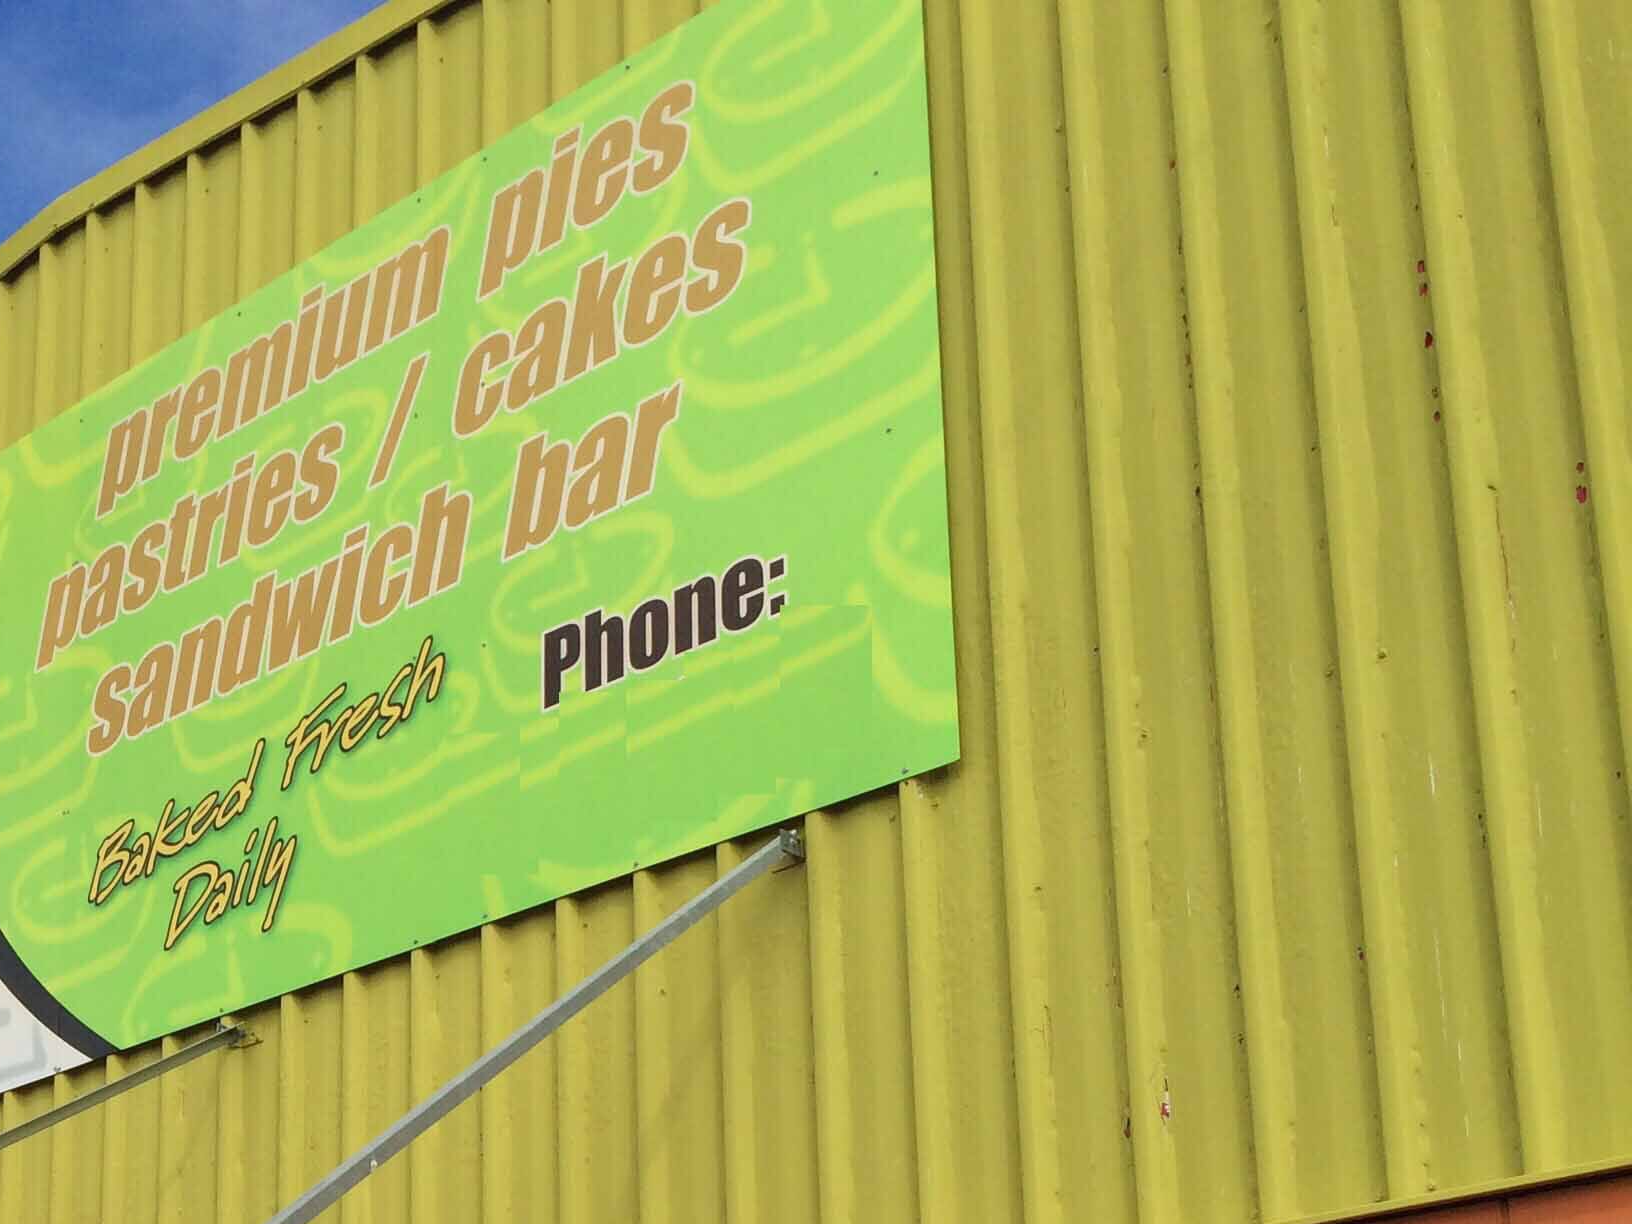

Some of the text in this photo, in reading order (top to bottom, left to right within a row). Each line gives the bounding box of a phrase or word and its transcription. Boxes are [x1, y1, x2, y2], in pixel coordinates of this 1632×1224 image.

[36, 198, 749, 670] pastries / cakes
[97, 80, 694, 514] premium pies
[87, 381, 682, 756] sandwich bar
[543, 556, 786, 710] Phone:
[87, 634, 446, 905] Baked Fresh
[164, 816, 298, 951] Daily
